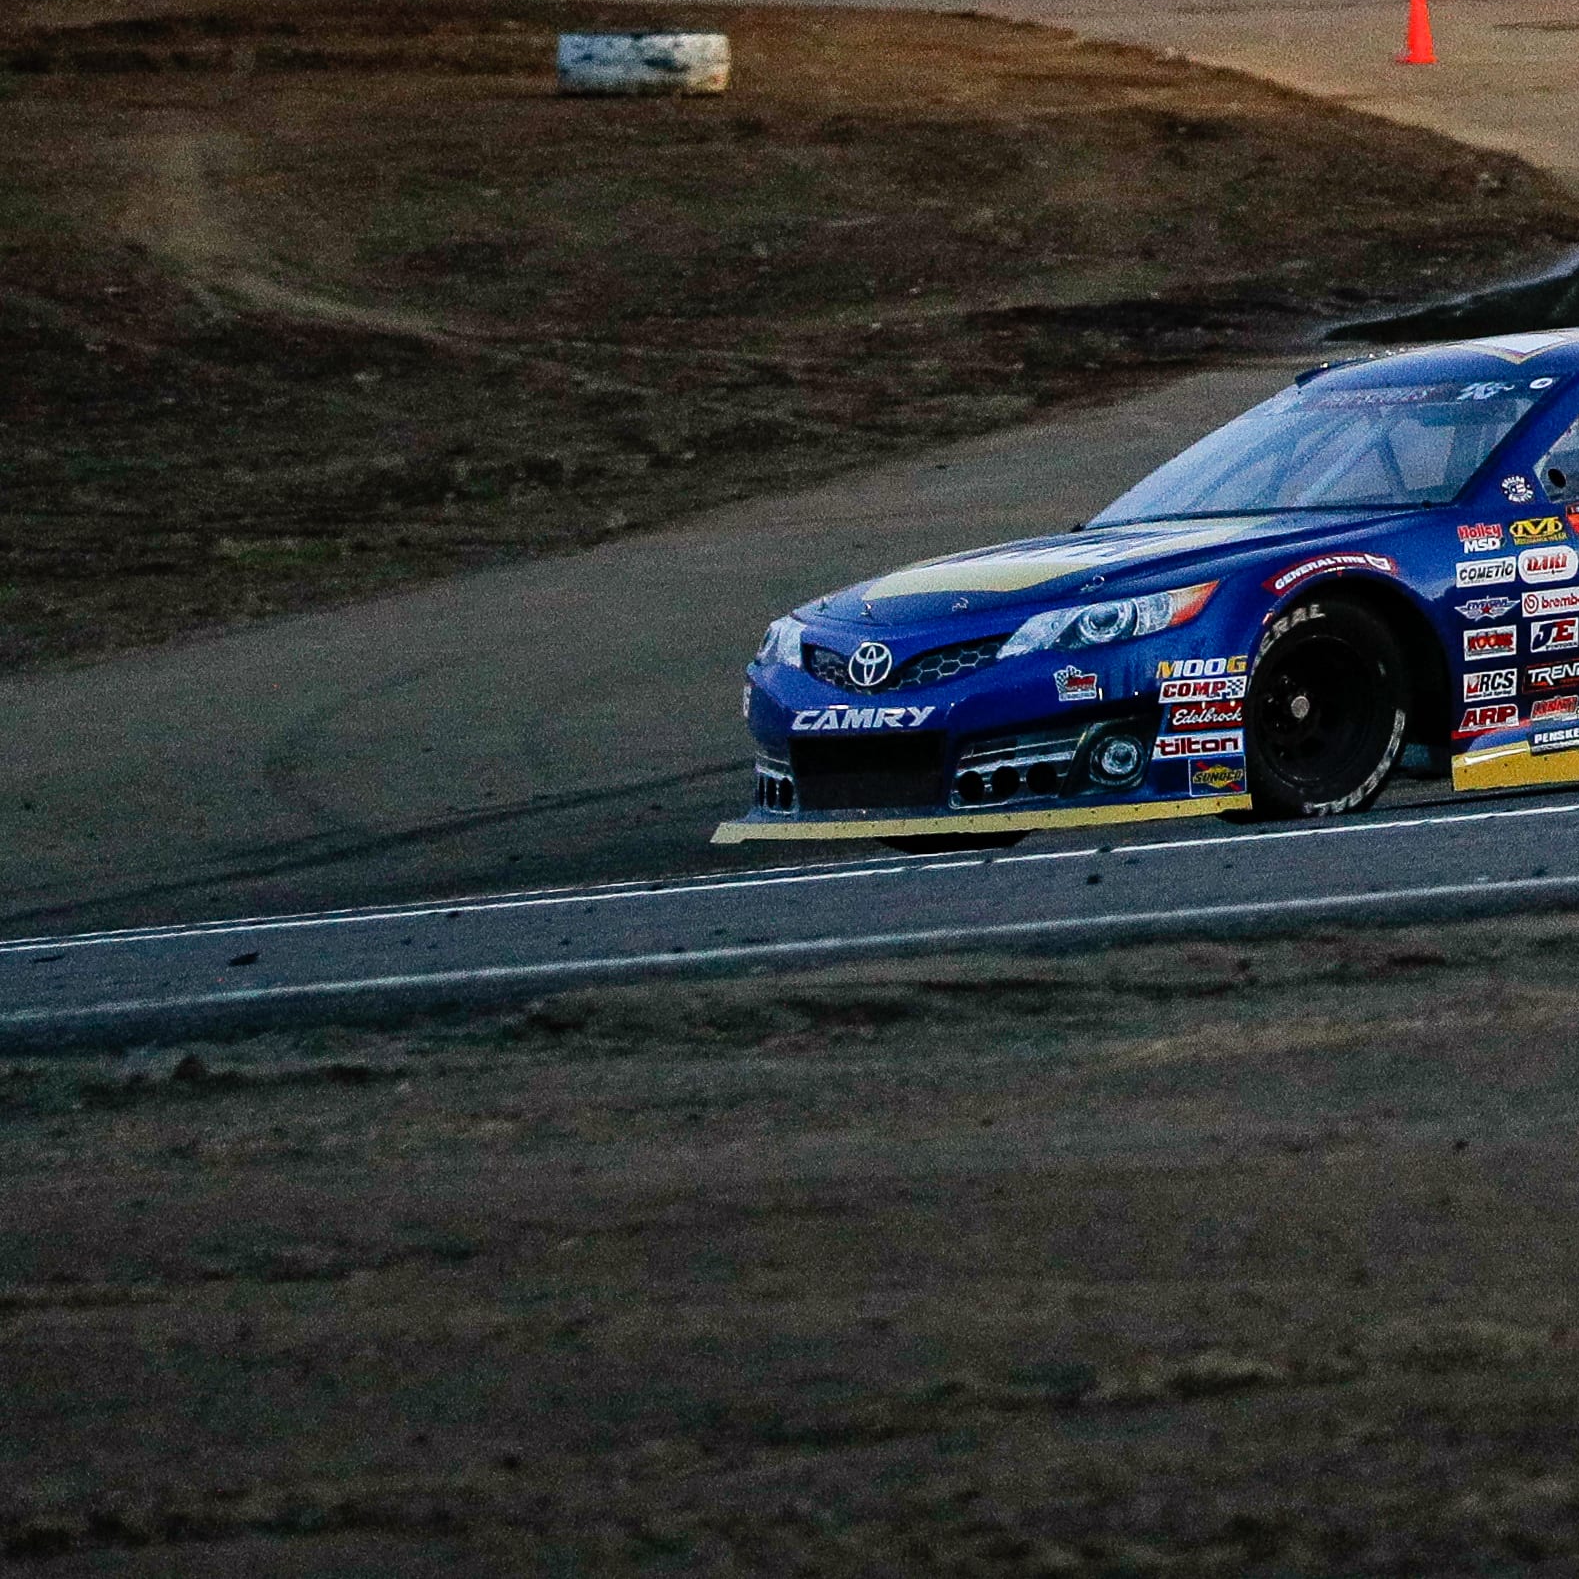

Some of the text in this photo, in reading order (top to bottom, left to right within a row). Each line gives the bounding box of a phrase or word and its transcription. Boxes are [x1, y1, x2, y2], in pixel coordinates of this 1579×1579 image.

[1458, 523, 1502, 541] Holley
[1464, 538, 1500, 553] MSD
[1275, 557, 1336, 590] GENERAL
[1531, 619, 1576, 650] JE
[1156, 654, 1248, 678] MOOG
[1162, 681, 1227, 698] COMP
[1480, 671, 1514, 692] RCS
[791, 706, 935, 731] CAMRY
[1172, 707, 1243, 726] Edelbrock
[1462, 705, 1516, 727] ARP
[1156, 736, 1239, 756] tilton
[1534, 728, 1579, 744] PENSKE
[1193, 768, 1244, 784] SUNOCO
